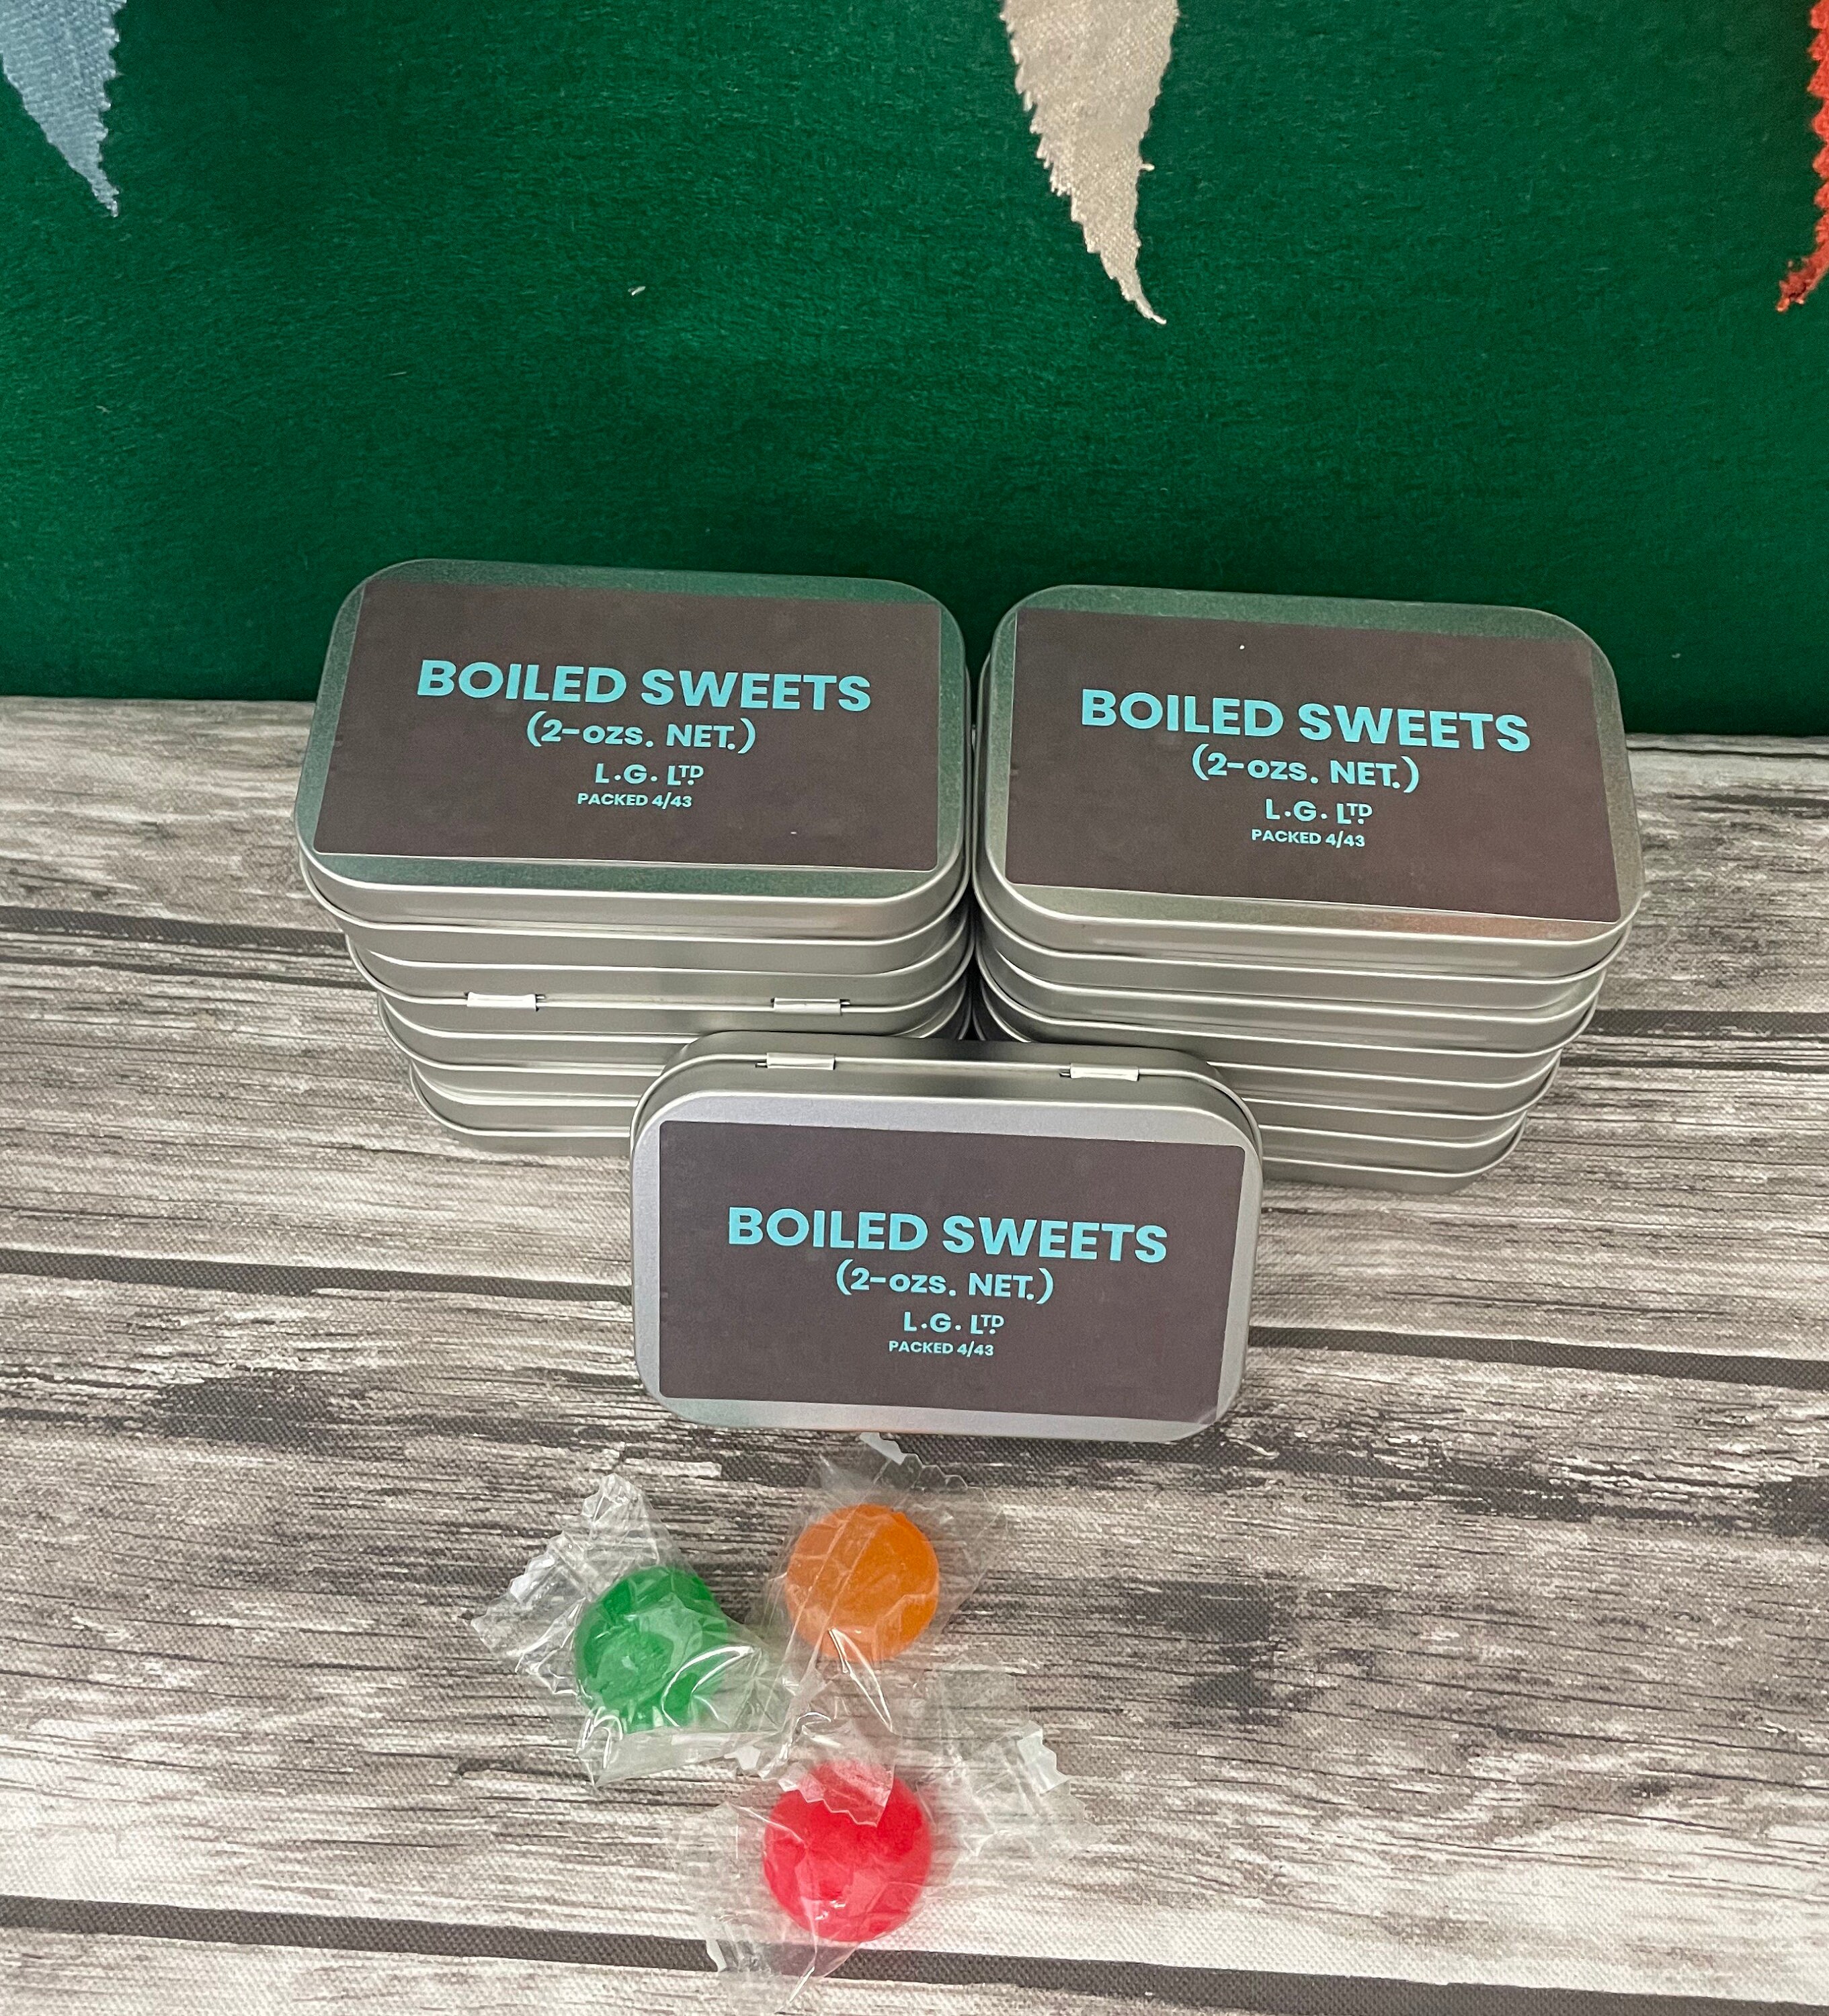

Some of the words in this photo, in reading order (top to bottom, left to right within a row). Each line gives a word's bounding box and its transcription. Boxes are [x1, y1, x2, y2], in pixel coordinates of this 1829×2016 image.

[417, 659, 626, 703] BOILED
[640, 669, 870, 712] SWEETS
[666, 718, 756, 753] NET.)
[1081, 689, 1283, 737] BOILED
[1297, 703, 1530, 752] SWEETS
[1330, 757, 1419, 792] NET.)
[577, 793, 649, 806] PACKED
[651, 792, 692, 809] 4/43
[1251, 829, 1322, 845] PACKED
[1325, 831, 1366, 848] 4/43
[729, 1207, 928, 1251] BOILED
[942, 1215, 1167, 1263] SWEETS
[969, 1269, 1053, 1304] NET.)
[889, 1340, 954, 1354] PACKED
[957, 1341, 994, 1357] 4/43
